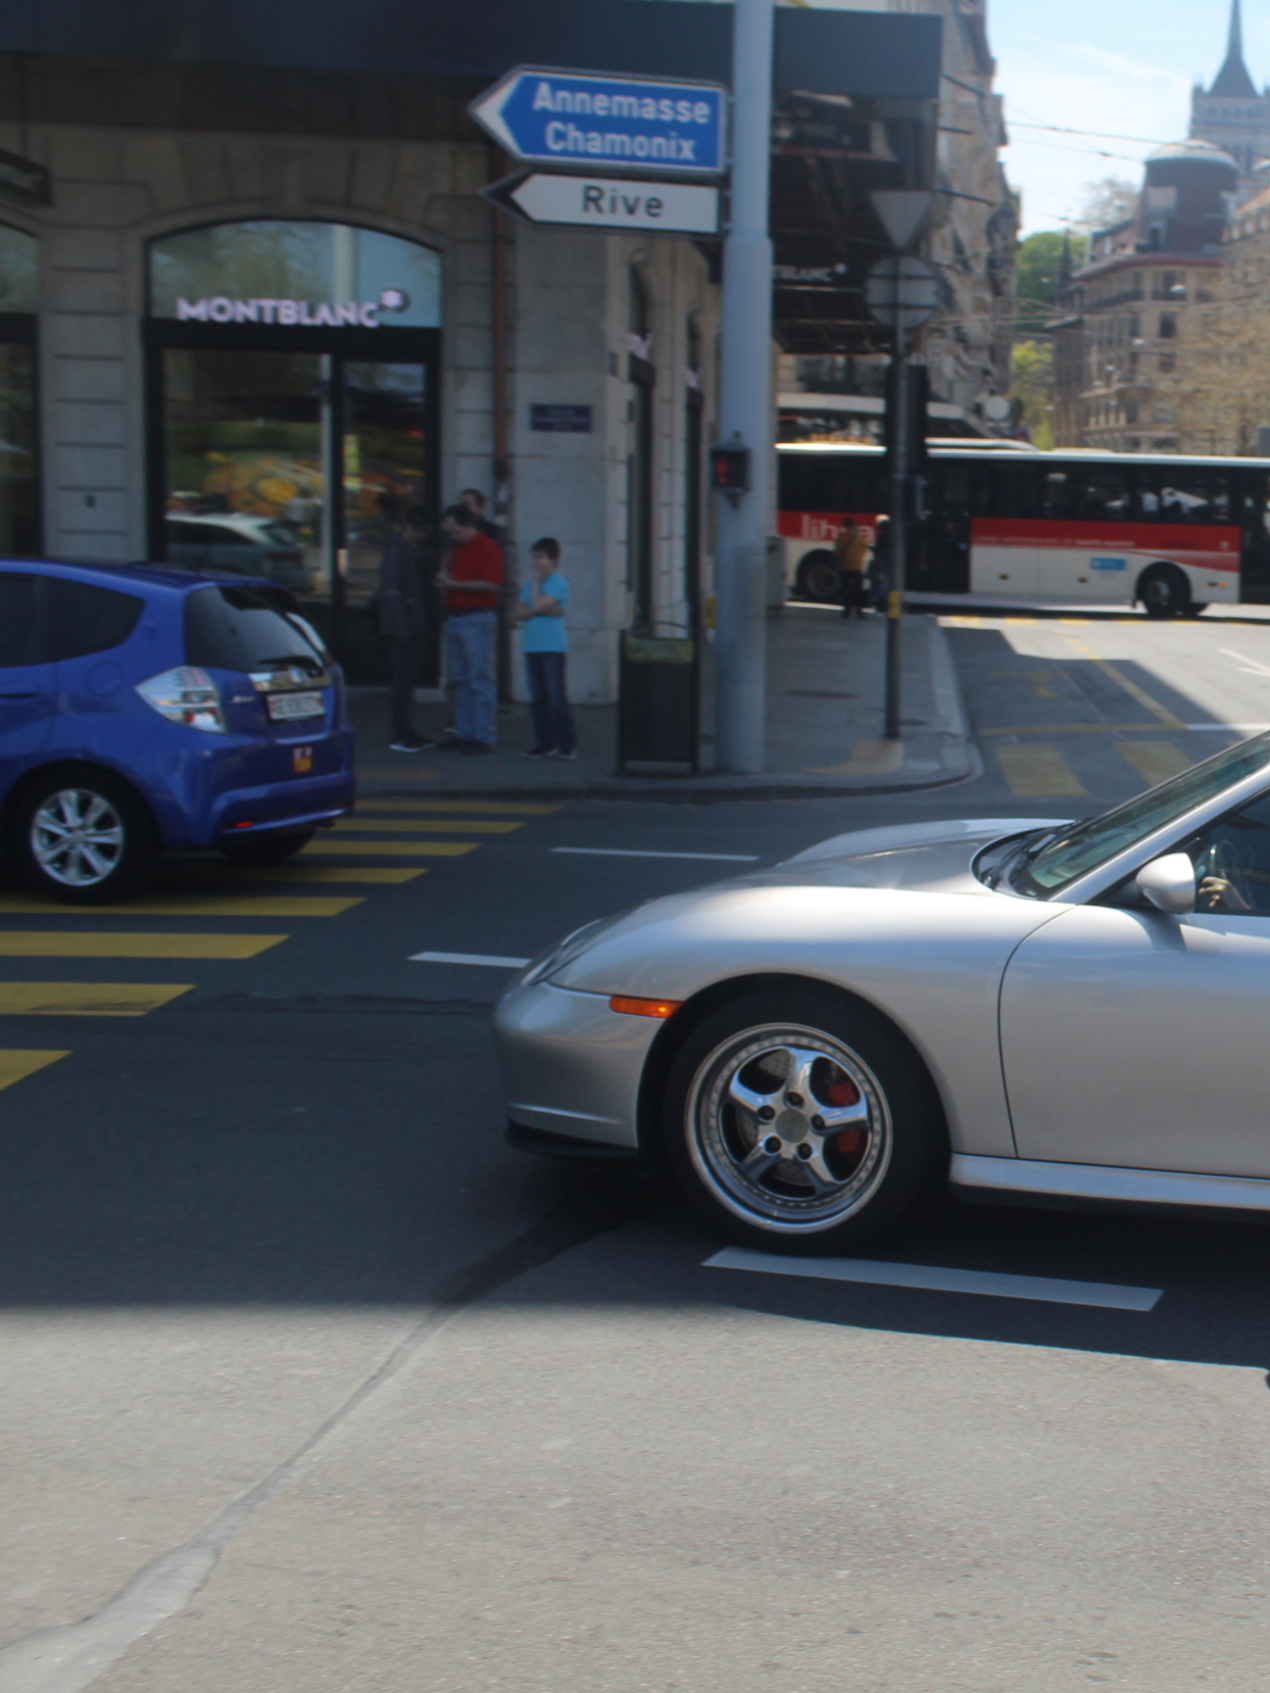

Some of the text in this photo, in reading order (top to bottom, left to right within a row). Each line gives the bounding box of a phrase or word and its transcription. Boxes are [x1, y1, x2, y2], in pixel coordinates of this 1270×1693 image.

[532, 81, 712, 124] Annemasse
[545, 121, 695, 161] Chamonix
[582, 185, 663, 218] Rive
[176, 296, 379, 328] MONTBLANC
